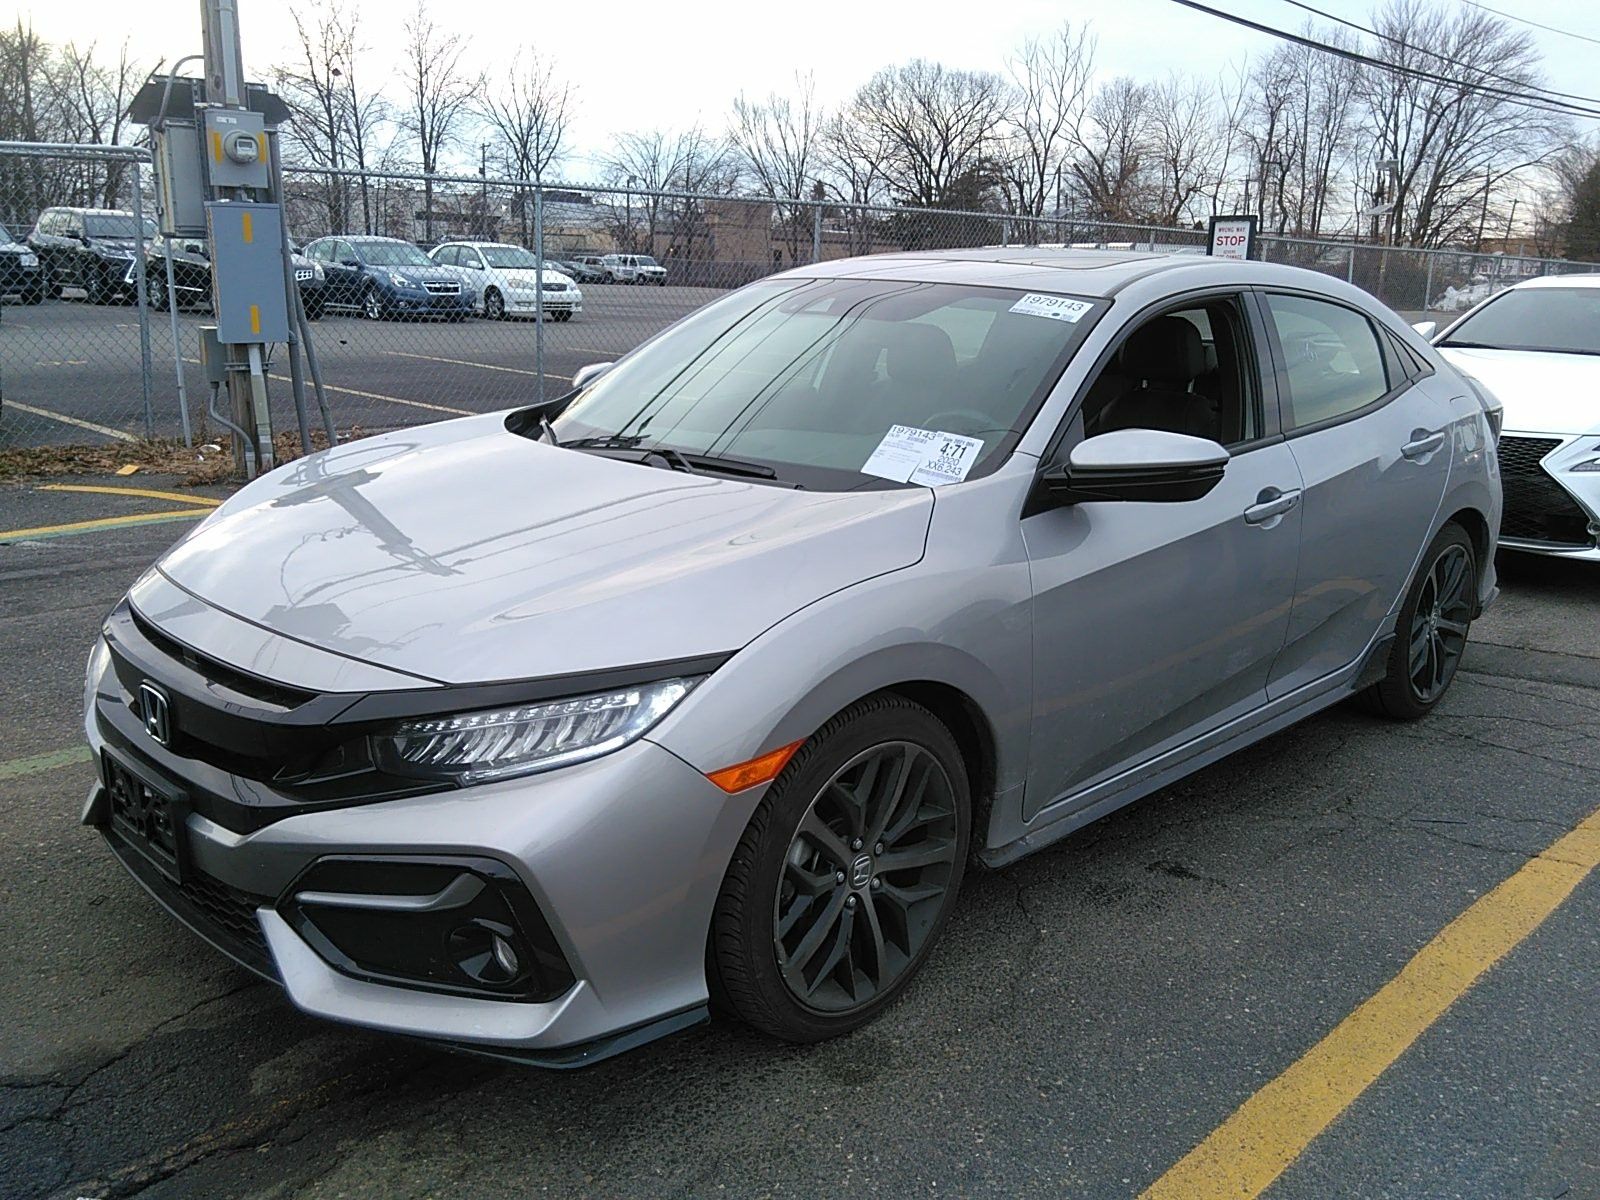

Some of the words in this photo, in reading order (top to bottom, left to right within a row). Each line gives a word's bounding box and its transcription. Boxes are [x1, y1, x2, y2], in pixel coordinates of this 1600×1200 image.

[1216, 235, 1246, 246] STOP
[1024, 295, 1084, 312] 1979143
[892, 425, 937, 441] 1979143
[940, 442, 967, 459] 4:71
[937, 455, 960, 467] 2020
